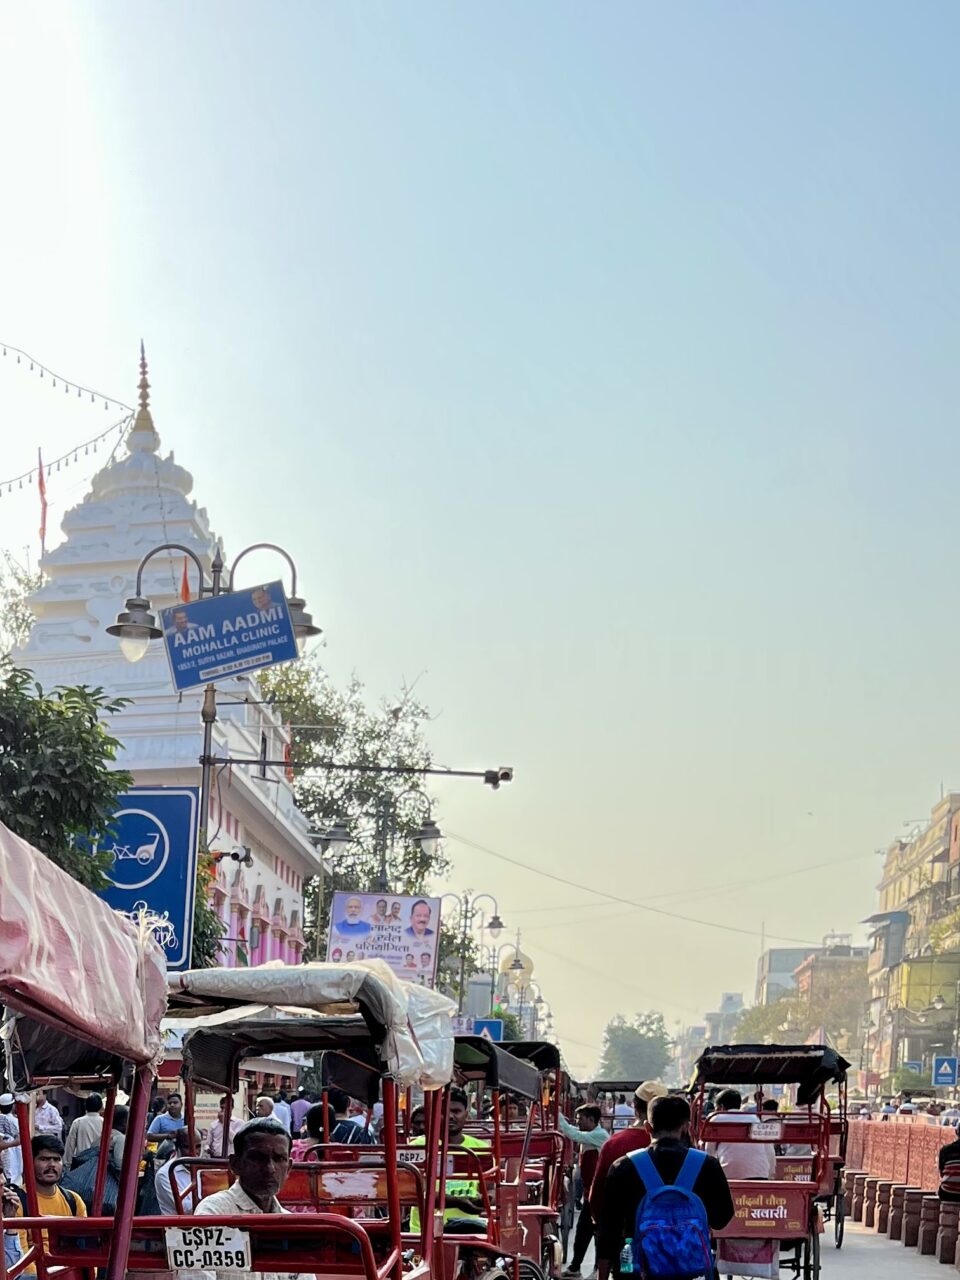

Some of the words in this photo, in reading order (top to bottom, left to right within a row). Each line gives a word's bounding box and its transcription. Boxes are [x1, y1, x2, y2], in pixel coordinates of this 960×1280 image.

[173, 624, 216, 647] AAM
[222, 606, 284, 634] AADMI
[182, 636, 239, 659] MOHALLA
[241, 624, 280, 643] CLINIC
[182, 1228, 232, 1246] CSPZ-
